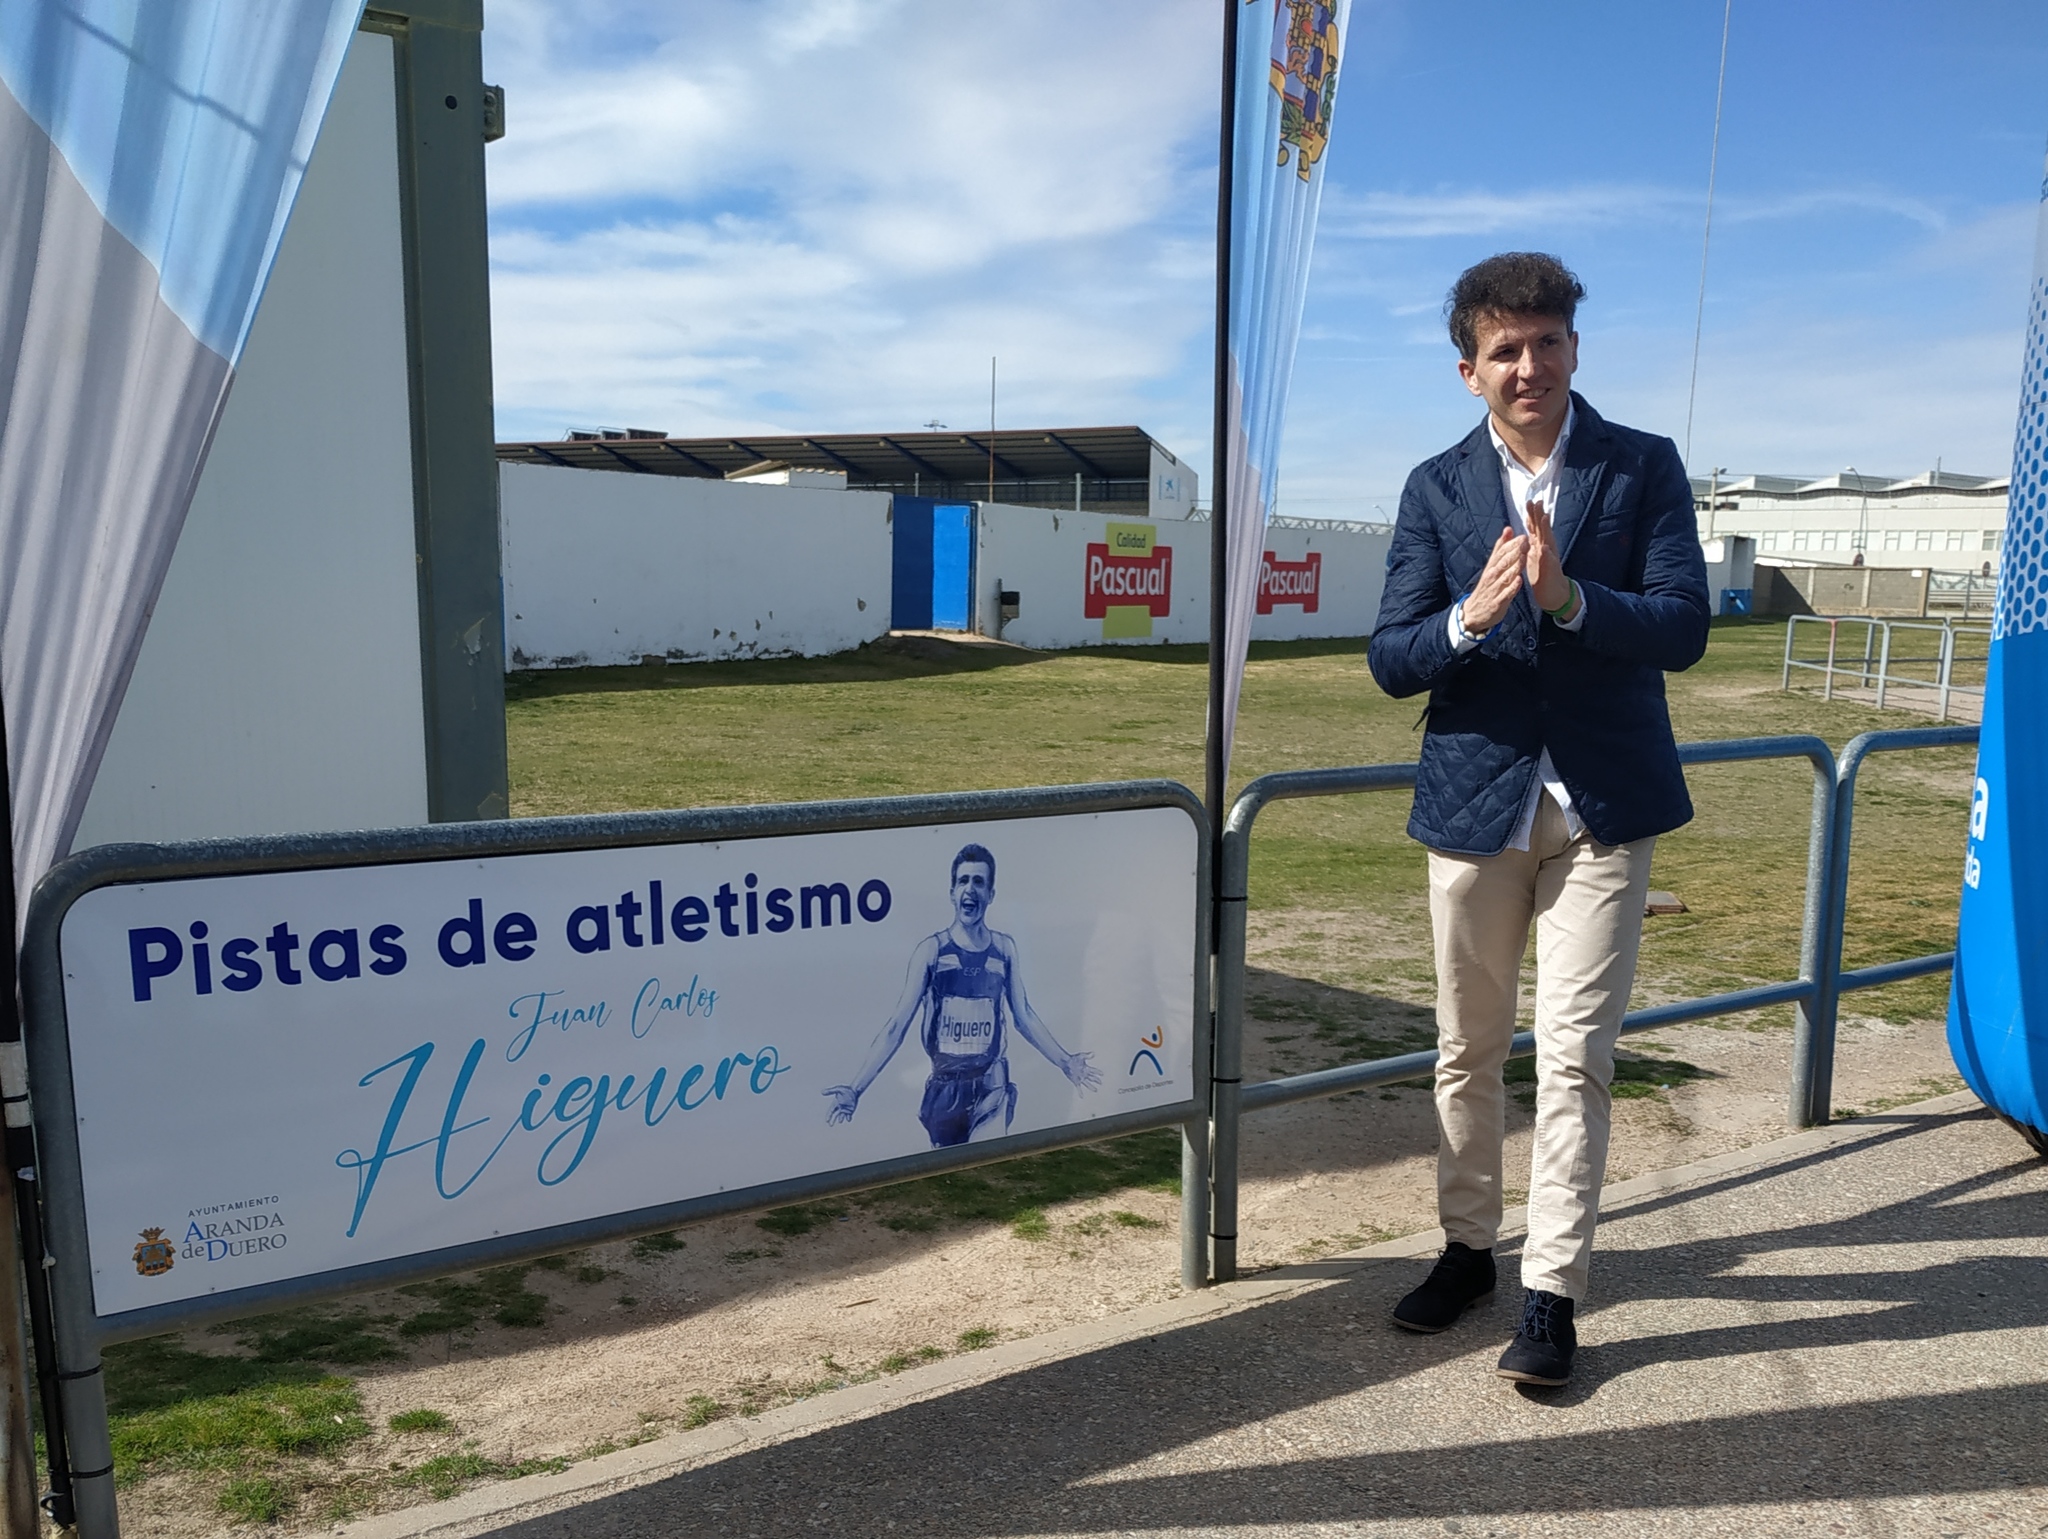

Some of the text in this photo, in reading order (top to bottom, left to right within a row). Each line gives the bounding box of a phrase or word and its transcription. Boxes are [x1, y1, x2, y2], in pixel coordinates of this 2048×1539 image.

[1116, 532, 1146, 548] Calidad
[1090, 556, 1166, 596] Pascual
[1260, 561, 1316, 595] Pascual
[128, 873, 892, 1002] Pistas de atletismo
[506, 974, 720, 1062] Juan Carlos
[941, 1016, 991, 1042] Higuero
[335, 1037, 791, 1238] Higuero
[188, 1195, 279, 1217] AYUNTAMIENTO
[182, 1212, 284, 1243] ARANDA
